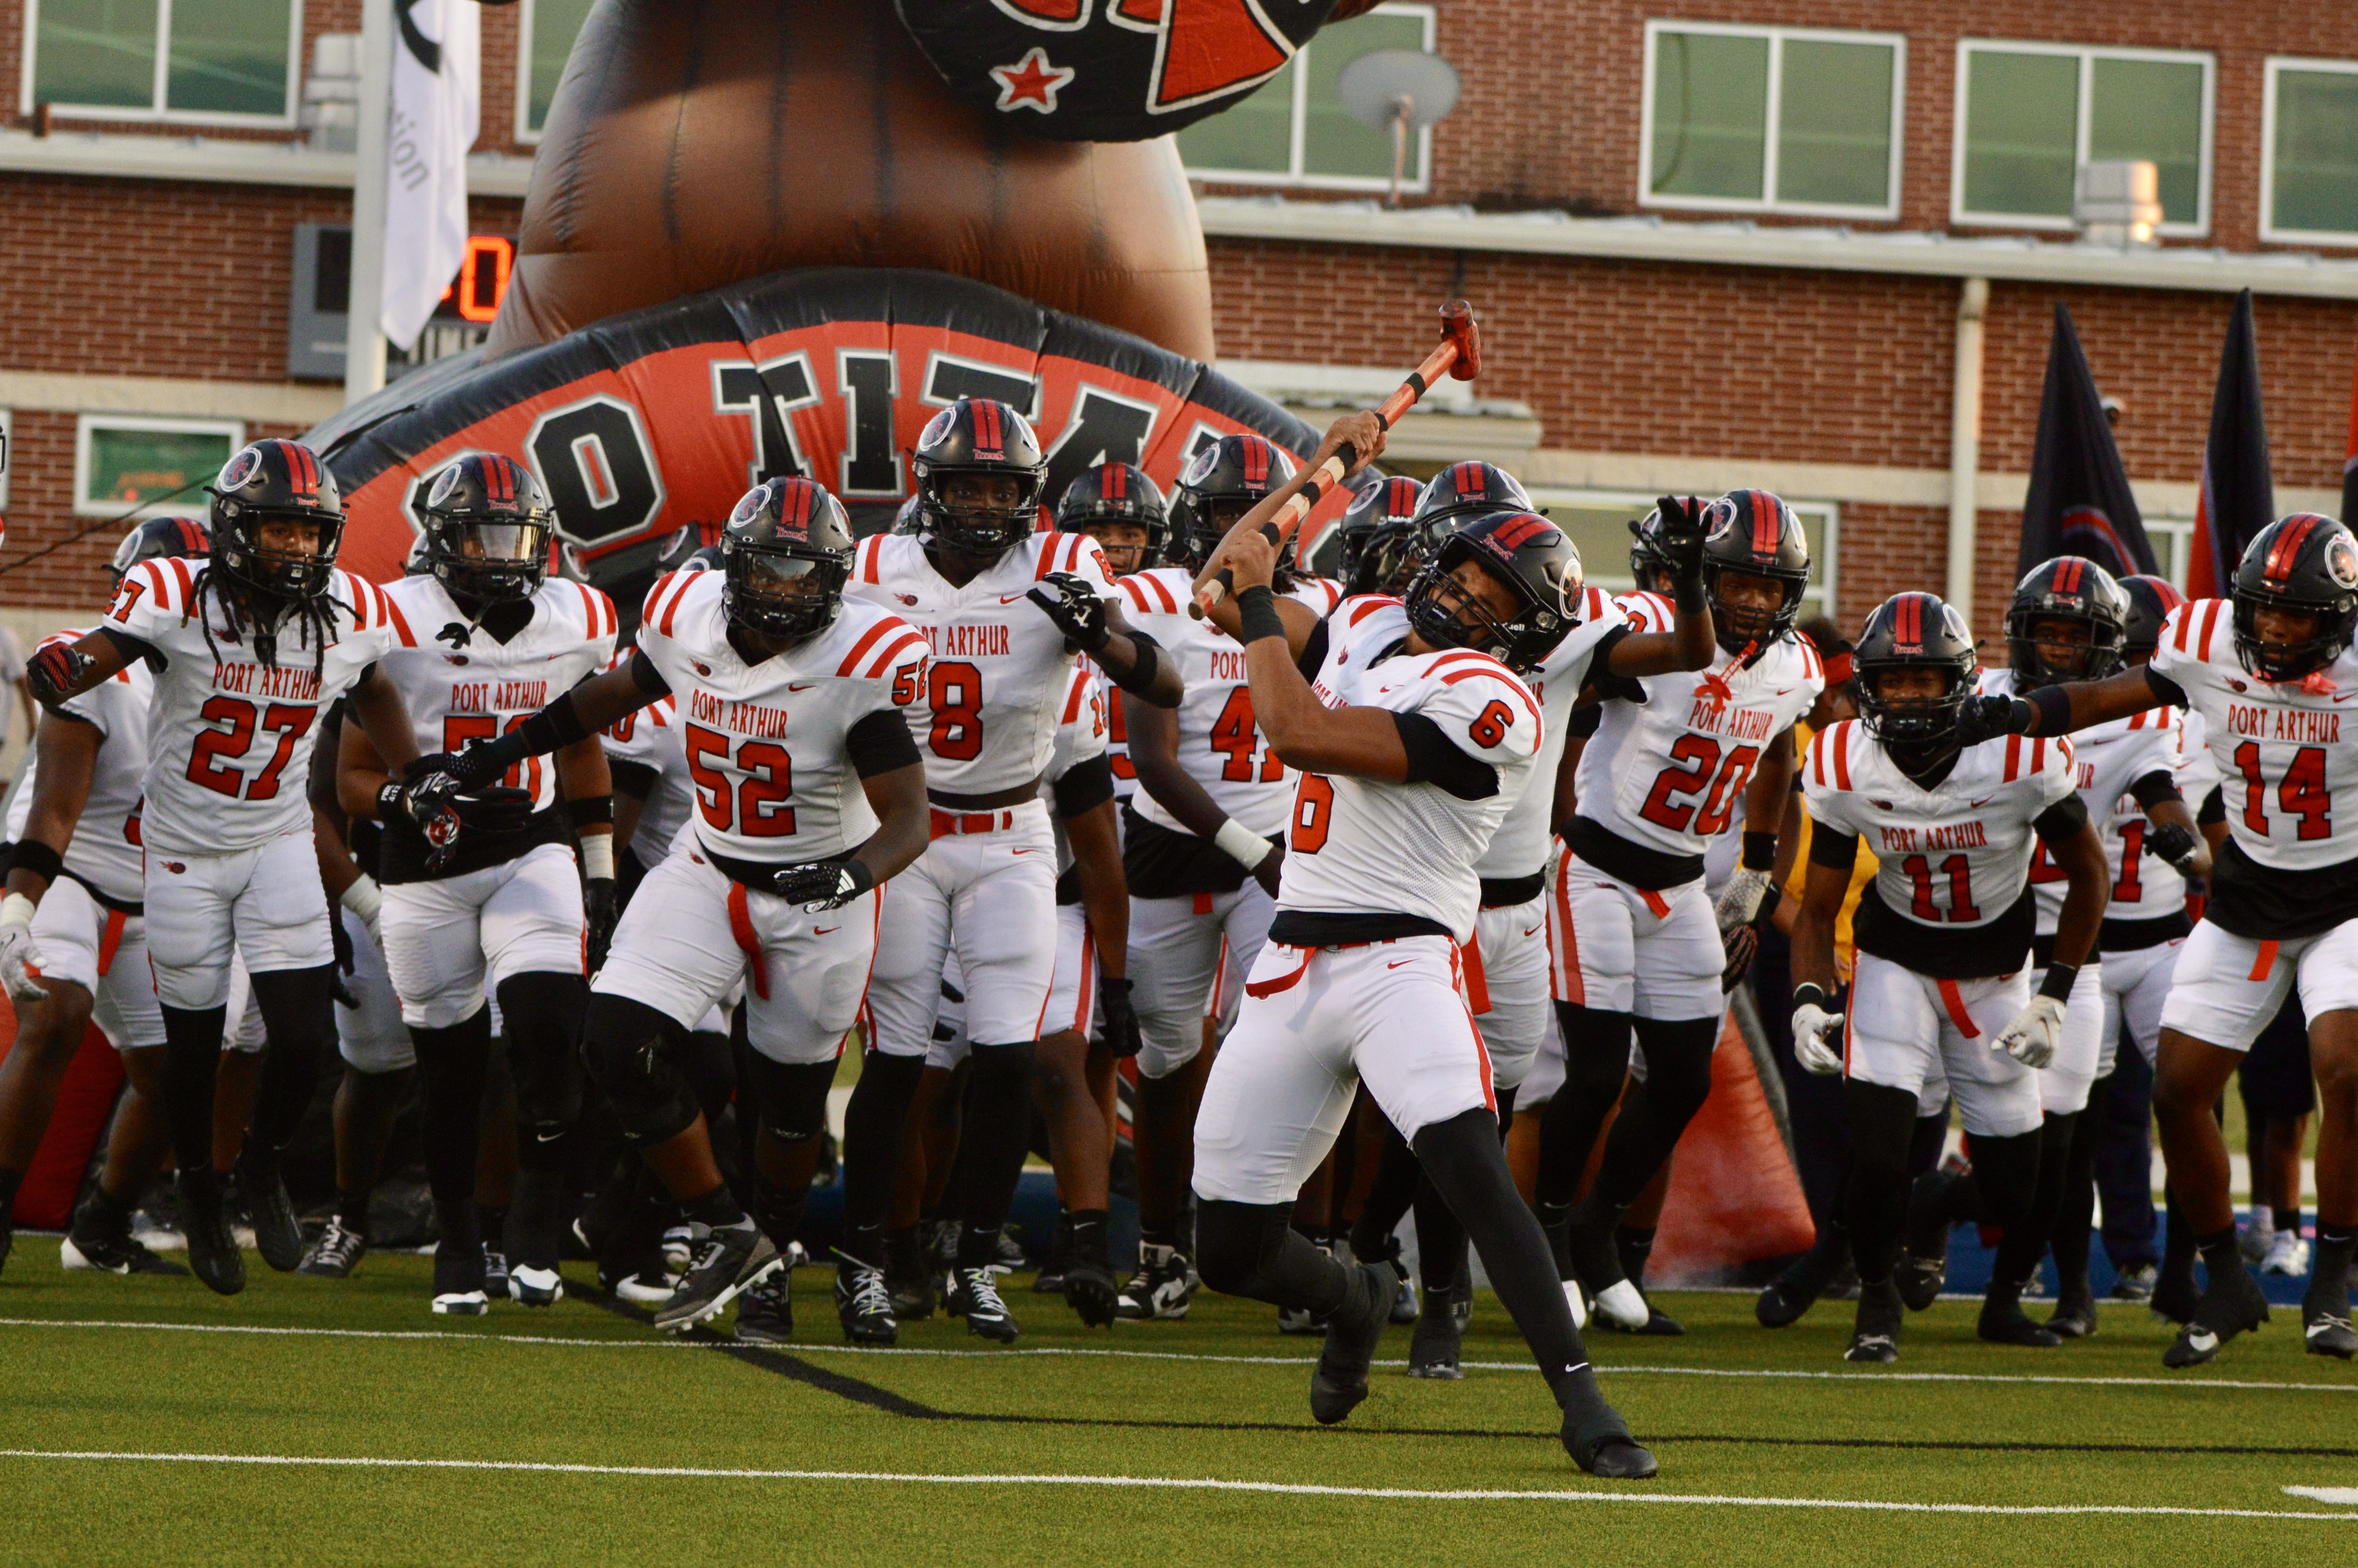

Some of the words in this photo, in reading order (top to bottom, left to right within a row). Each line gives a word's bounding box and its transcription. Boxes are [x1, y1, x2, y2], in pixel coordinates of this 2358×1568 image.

[946, 625, 1010, 656] ARTHUR
[1211, 651, 1246, 680] PORT
[212, 661, 255, 694] PORT
[259, 666, 323, 701] ARTHUR
[451, 684, 488, 711] PORT
[493, 681, 547, 711] ARTHUR
[691, 689, 724, 727] PORT
[728, 702, 788, 740] ARTHUR
[928, 661, 984, 762] 8
[1469, 699, 1515, 749] 6
[1688, 699, 1726, 734] PORT
[1726, 707, 1773, 741] ARTHUR
[2228, 704, 2268, 738] PORT
[2275, 709, 2340, 743] ARTHUR
[185, 695, 319, 800] 27
[686, 721, 797, 837] 52
[1638, 732, 1759, 836] 20
[2234, 740, 2331, 842] 14
[1880, 827, 1918, 851] PORT
[1925, 821, 1988, 851] ARTHUR
[2113, 819, 2147, 902] 1
[1902, 853, 1981, 923] 11
